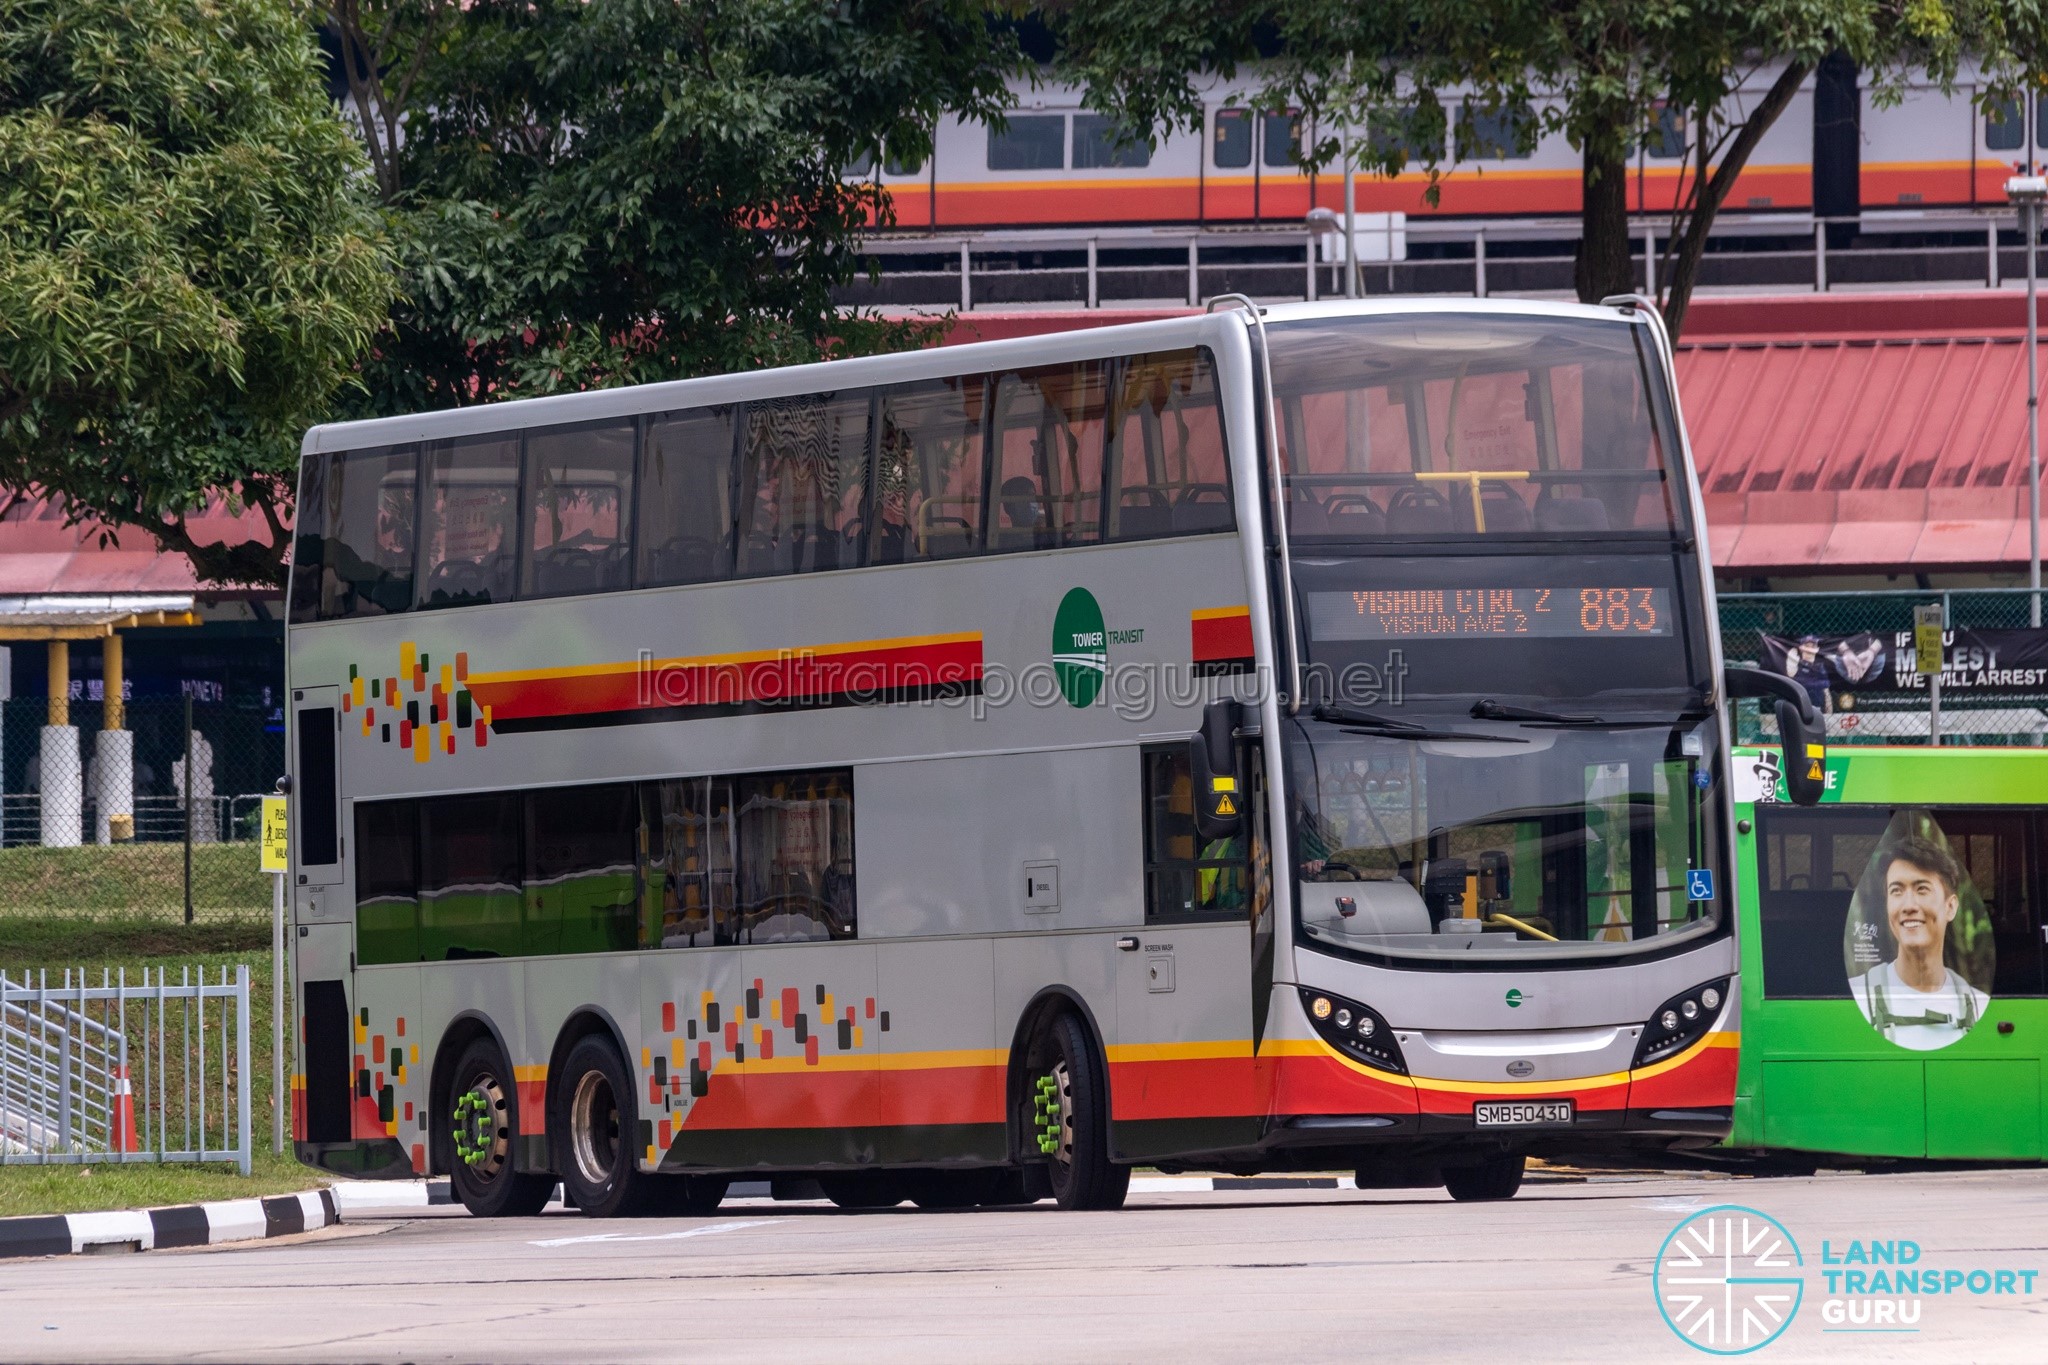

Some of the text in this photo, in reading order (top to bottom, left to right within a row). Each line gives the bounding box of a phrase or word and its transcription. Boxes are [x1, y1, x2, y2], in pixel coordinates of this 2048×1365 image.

[1352, 590, 1443, 614] YISHUN
[1580, 587, 1656, 631] 883
[1379, 614, 1528, 634] YISHUN AVE 2
[1072, 629, 1144, 647] TOWER TRANSIT
[1895, 631, 1912, 648] IF
[1895, 645, 1999, 673] MLEST
[1895, 671, 1926, 688] WE
[1975, 668, 2047, 686] ARREST
[1478, 1105, 1570, 1123] SMB5043D
